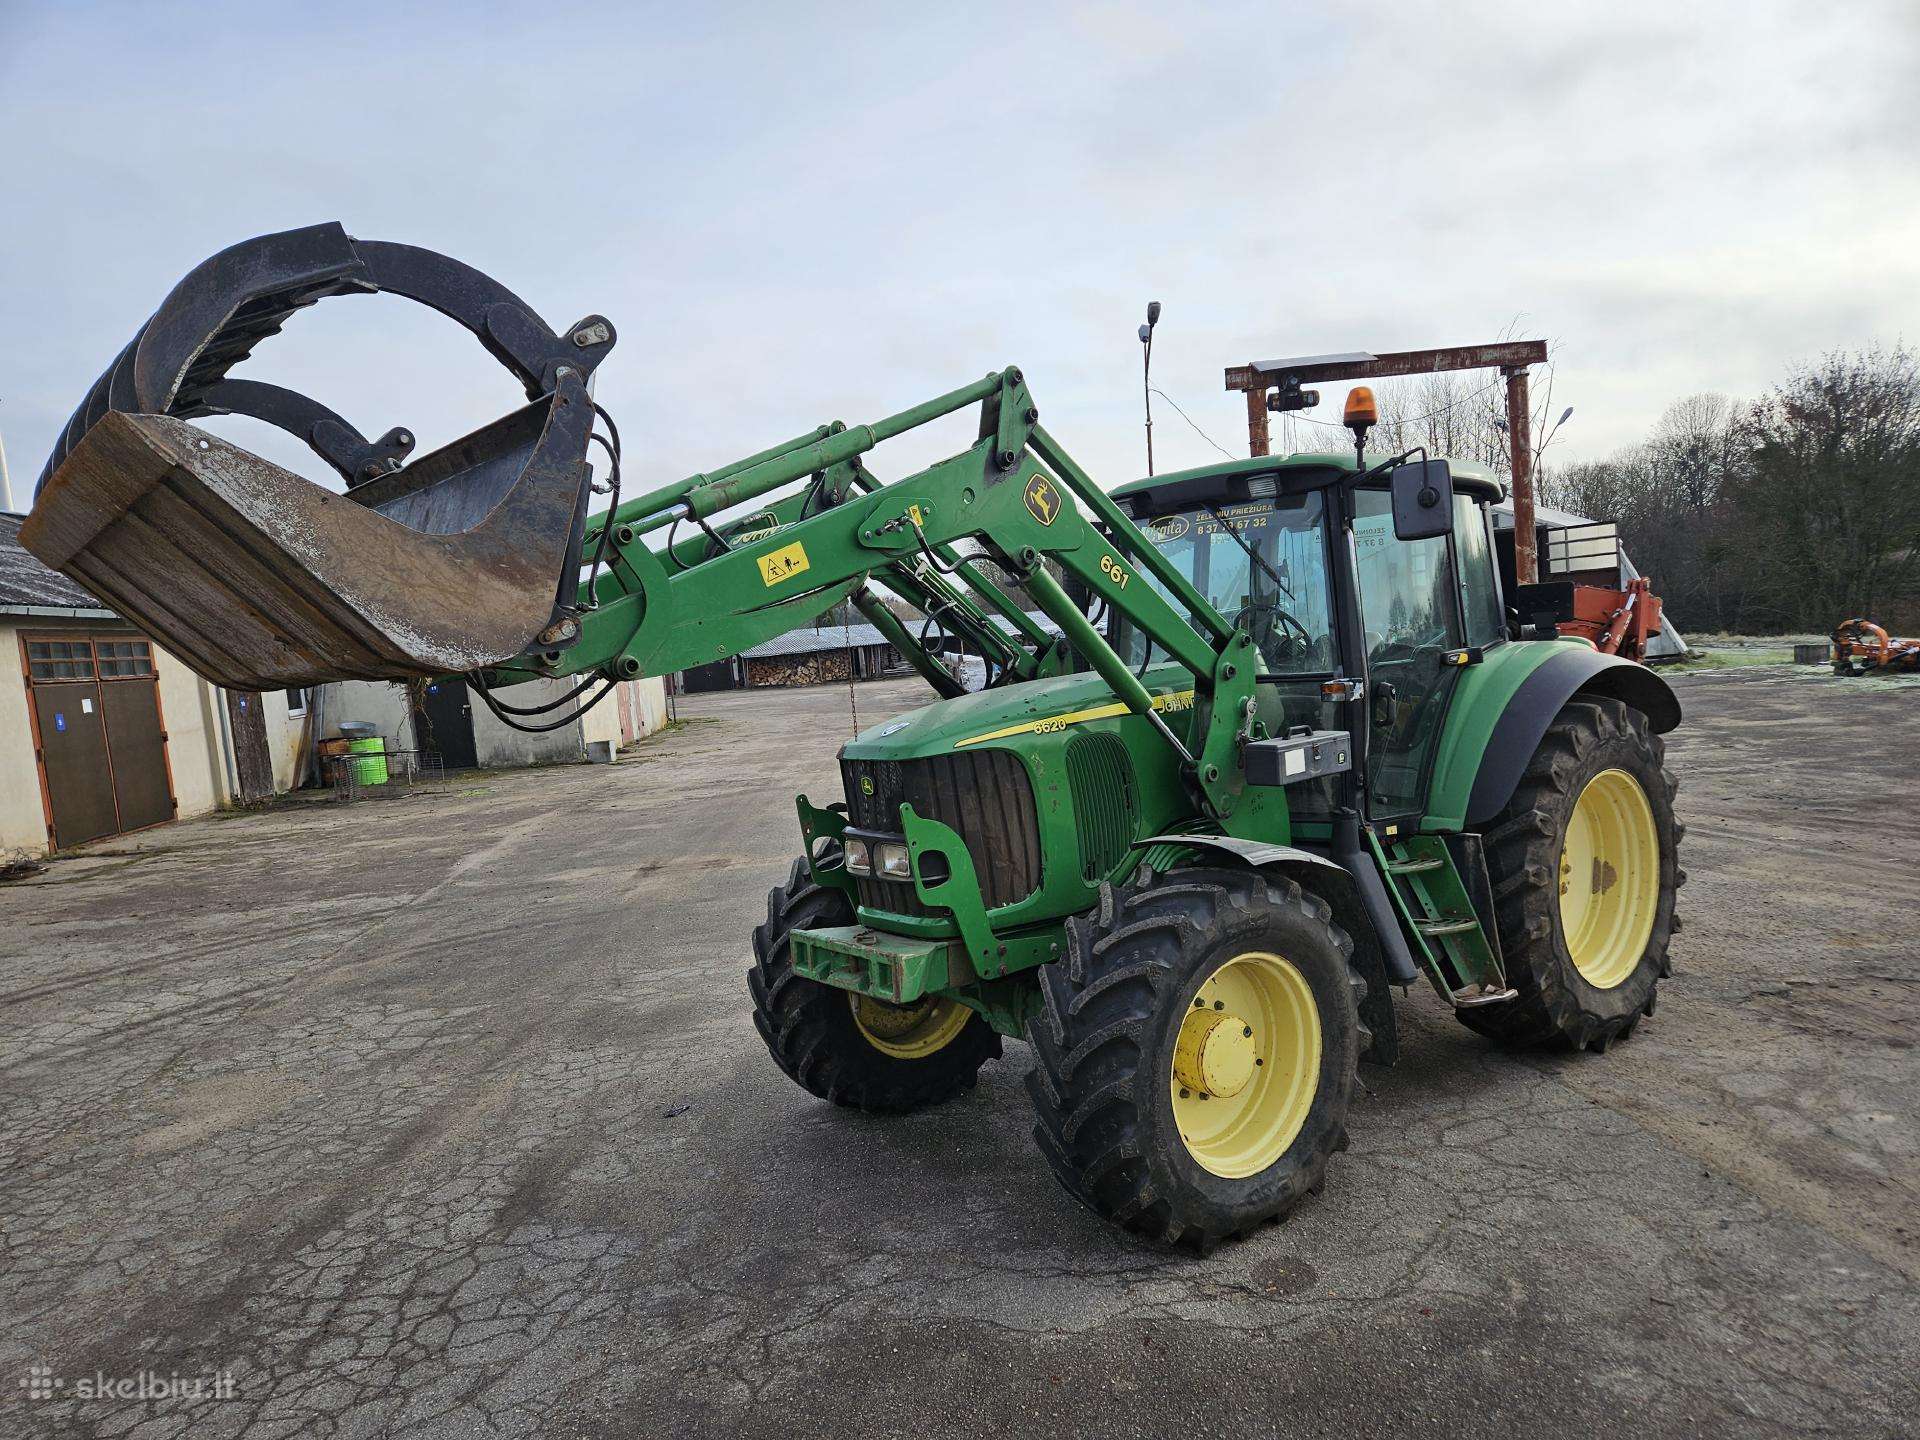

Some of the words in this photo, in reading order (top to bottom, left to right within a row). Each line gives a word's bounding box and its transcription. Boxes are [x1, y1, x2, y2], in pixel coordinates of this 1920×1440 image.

[1197, 526, 1204, 535] 8
[1206, 524, 1218, 533] 37
[1237, 520, 1250, 529] 67
[1253, 517, 1267, 527] 32
[1100, 555, 1130, 591] 661
[1033, 718, 1067, 735] 6620
